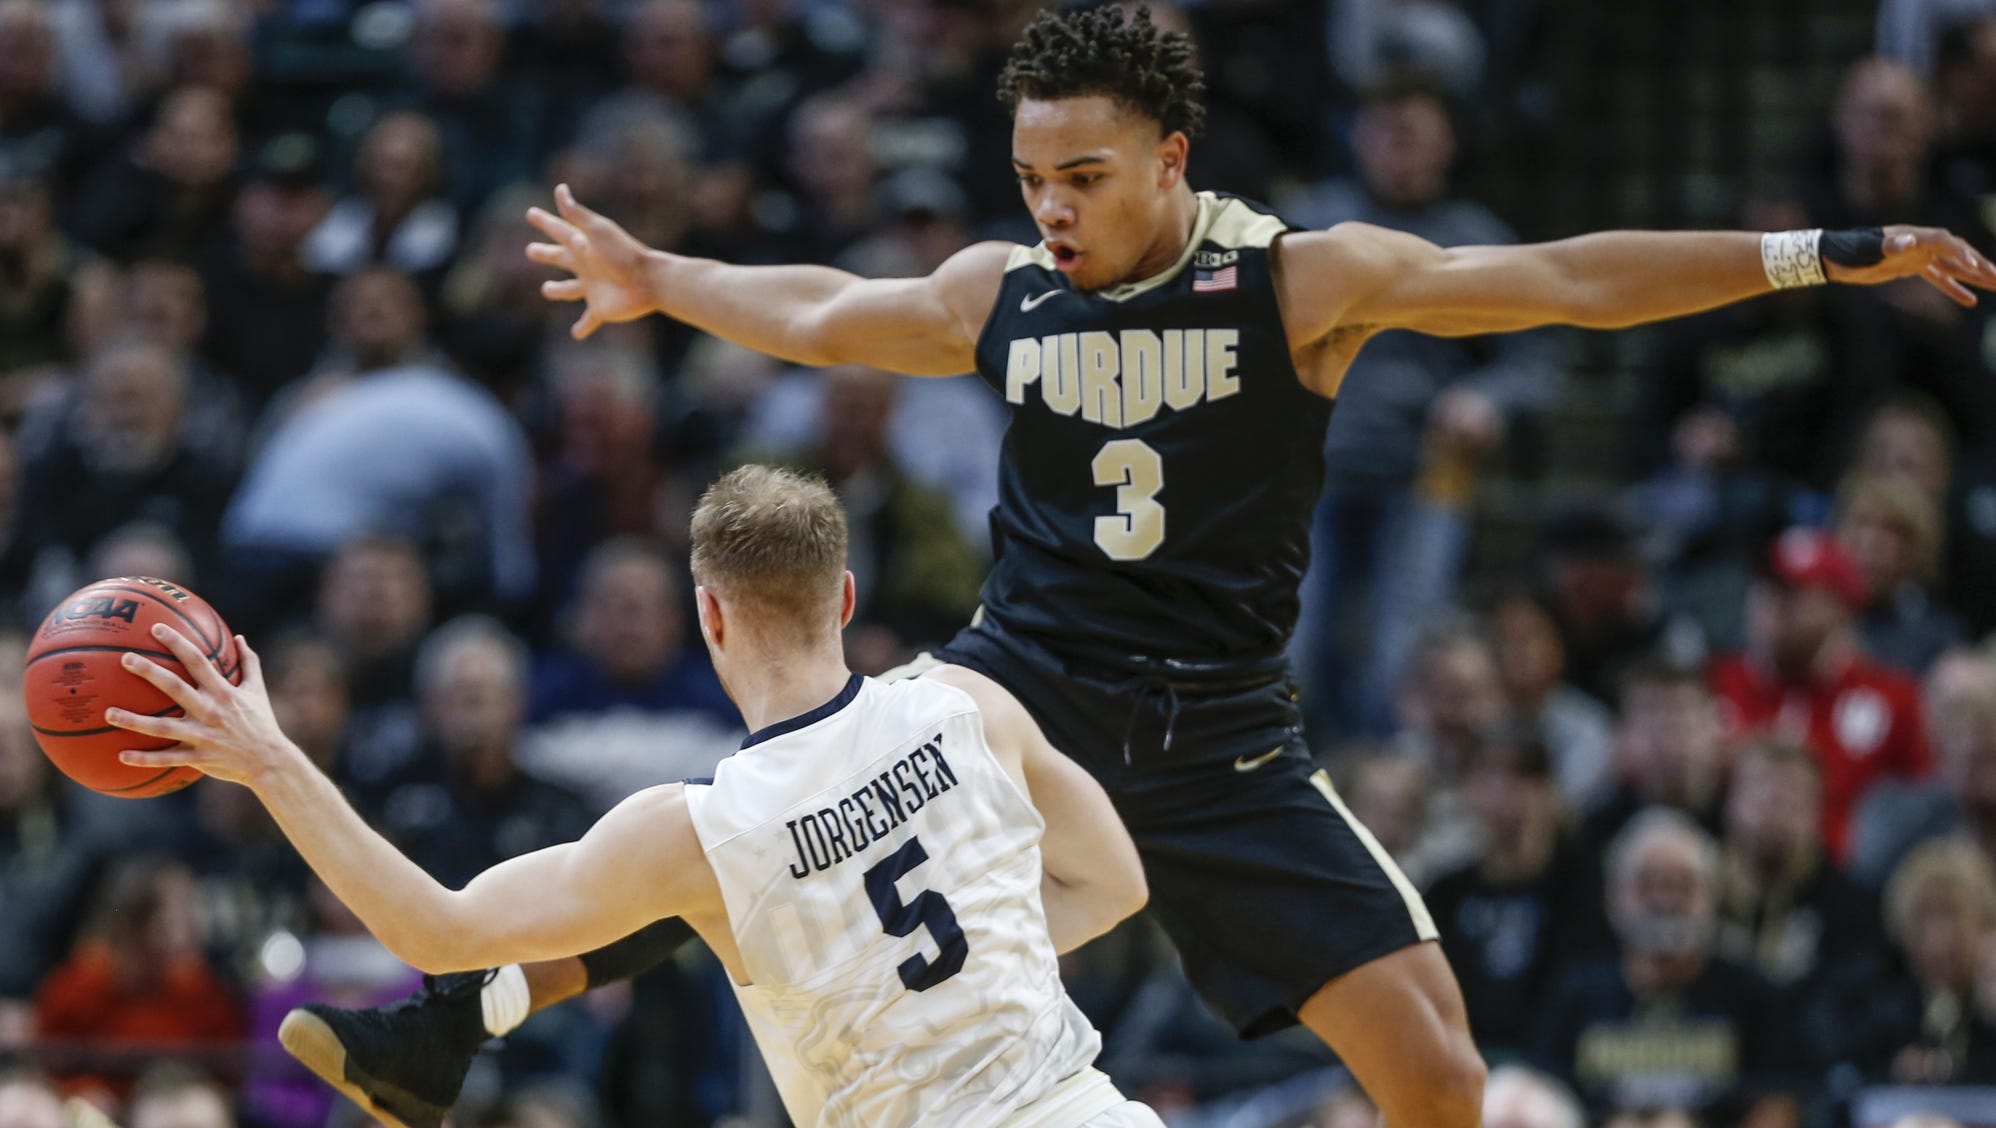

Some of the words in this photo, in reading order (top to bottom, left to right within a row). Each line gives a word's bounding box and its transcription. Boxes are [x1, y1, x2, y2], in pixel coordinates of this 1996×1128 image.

[1006, 329, 1240, 429] PURDUE
[1092, 439, 1164, 561] 3
[786, 733, 958, 879] JORGENSEN
[863, 835, 968, 992] 5
